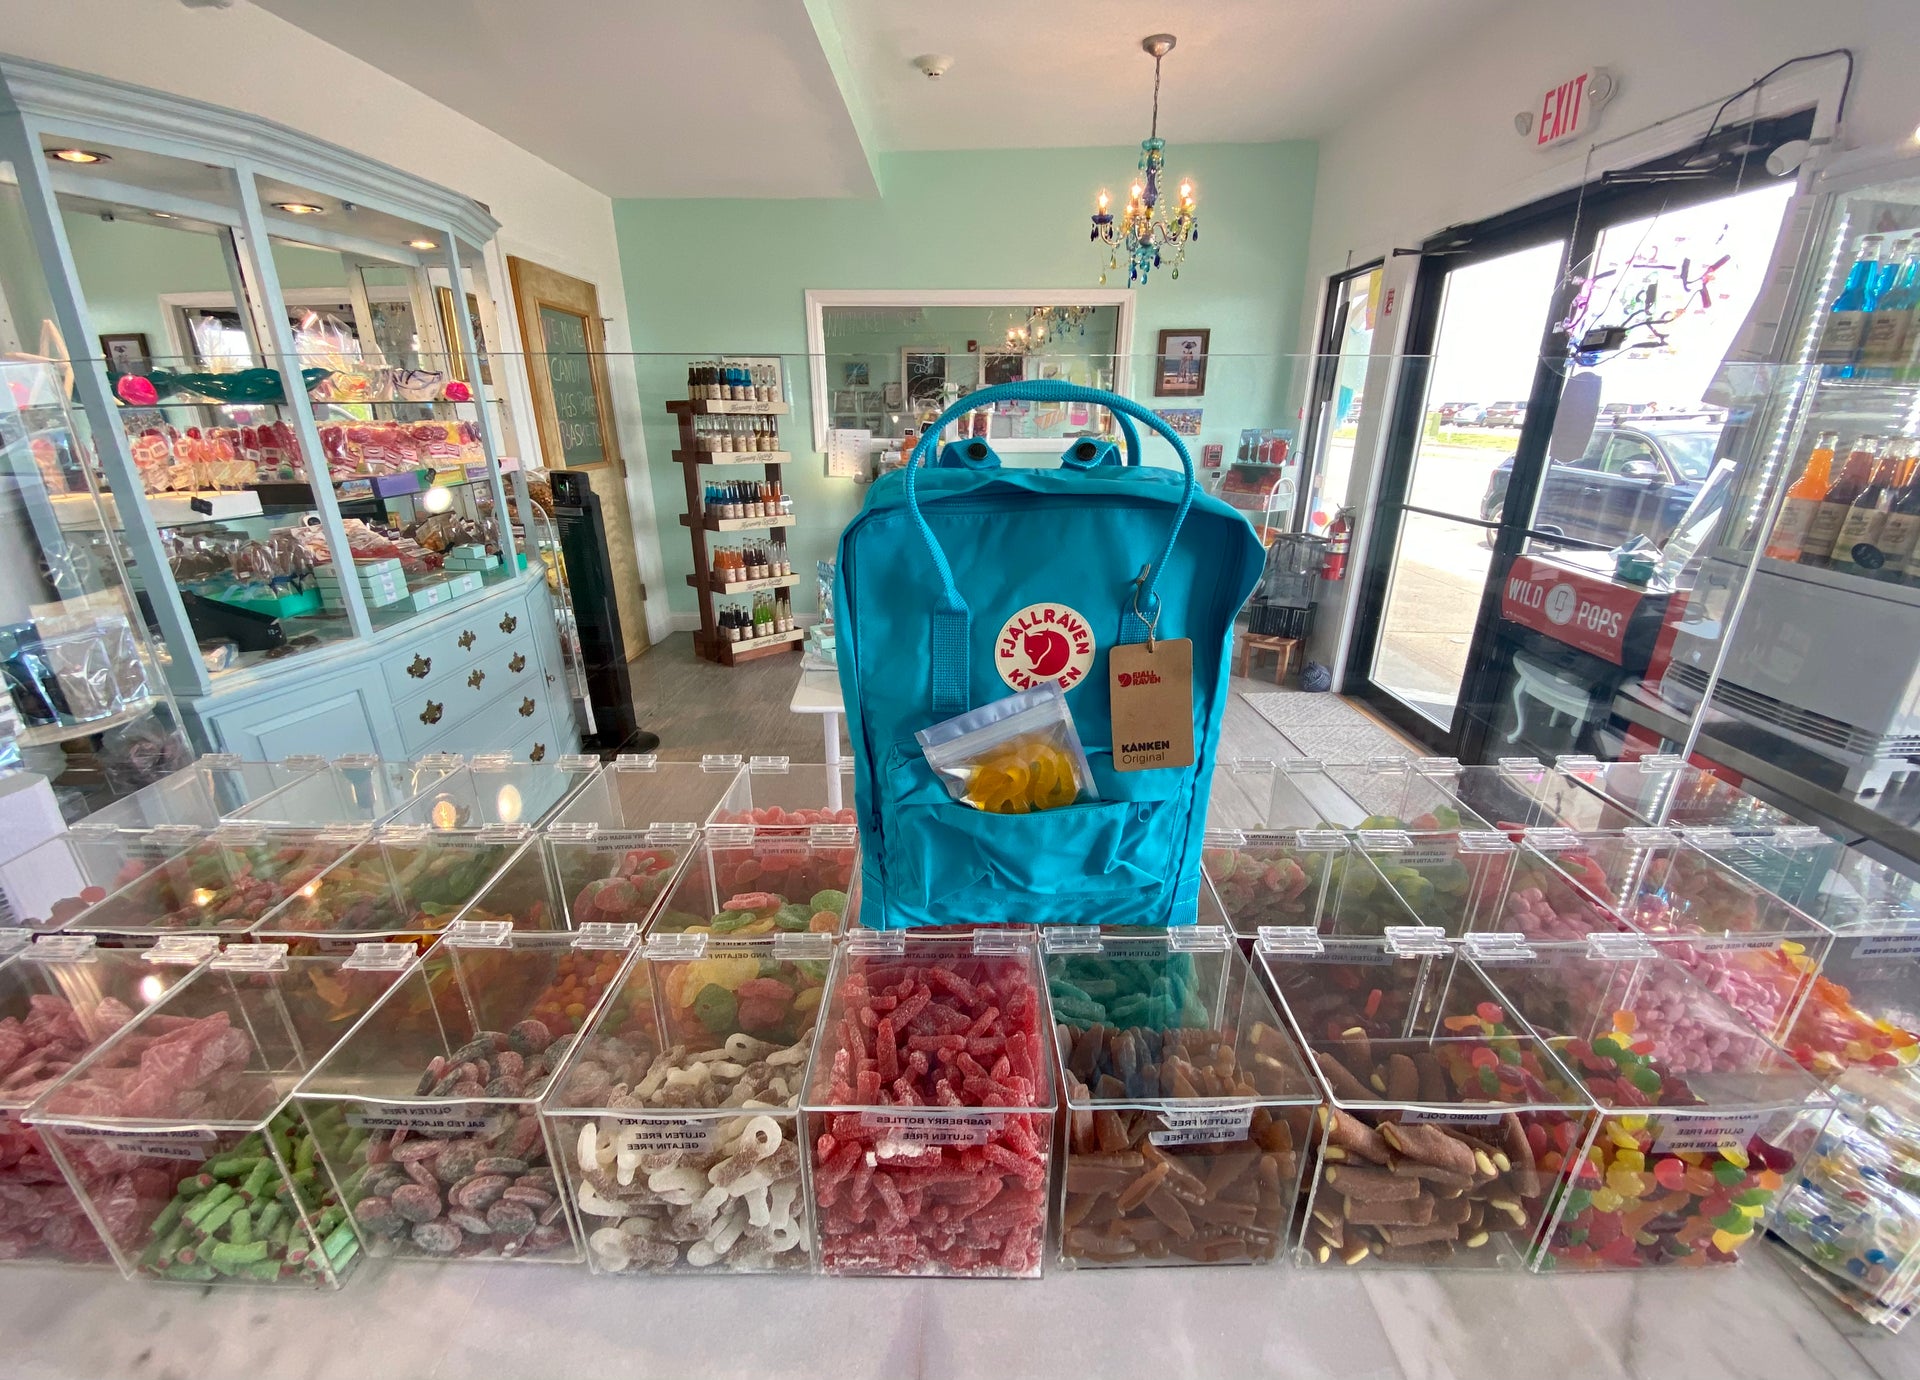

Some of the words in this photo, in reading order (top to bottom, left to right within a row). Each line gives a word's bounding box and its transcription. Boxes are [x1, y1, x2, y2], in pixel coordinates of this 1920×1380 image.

[1538, 73, 1588, 145] EXIT
[1508, 577, 1544, 609] WILD
[1576, 601, 1622, 638] POPS
[1122, 751, 1165, 764] Original
